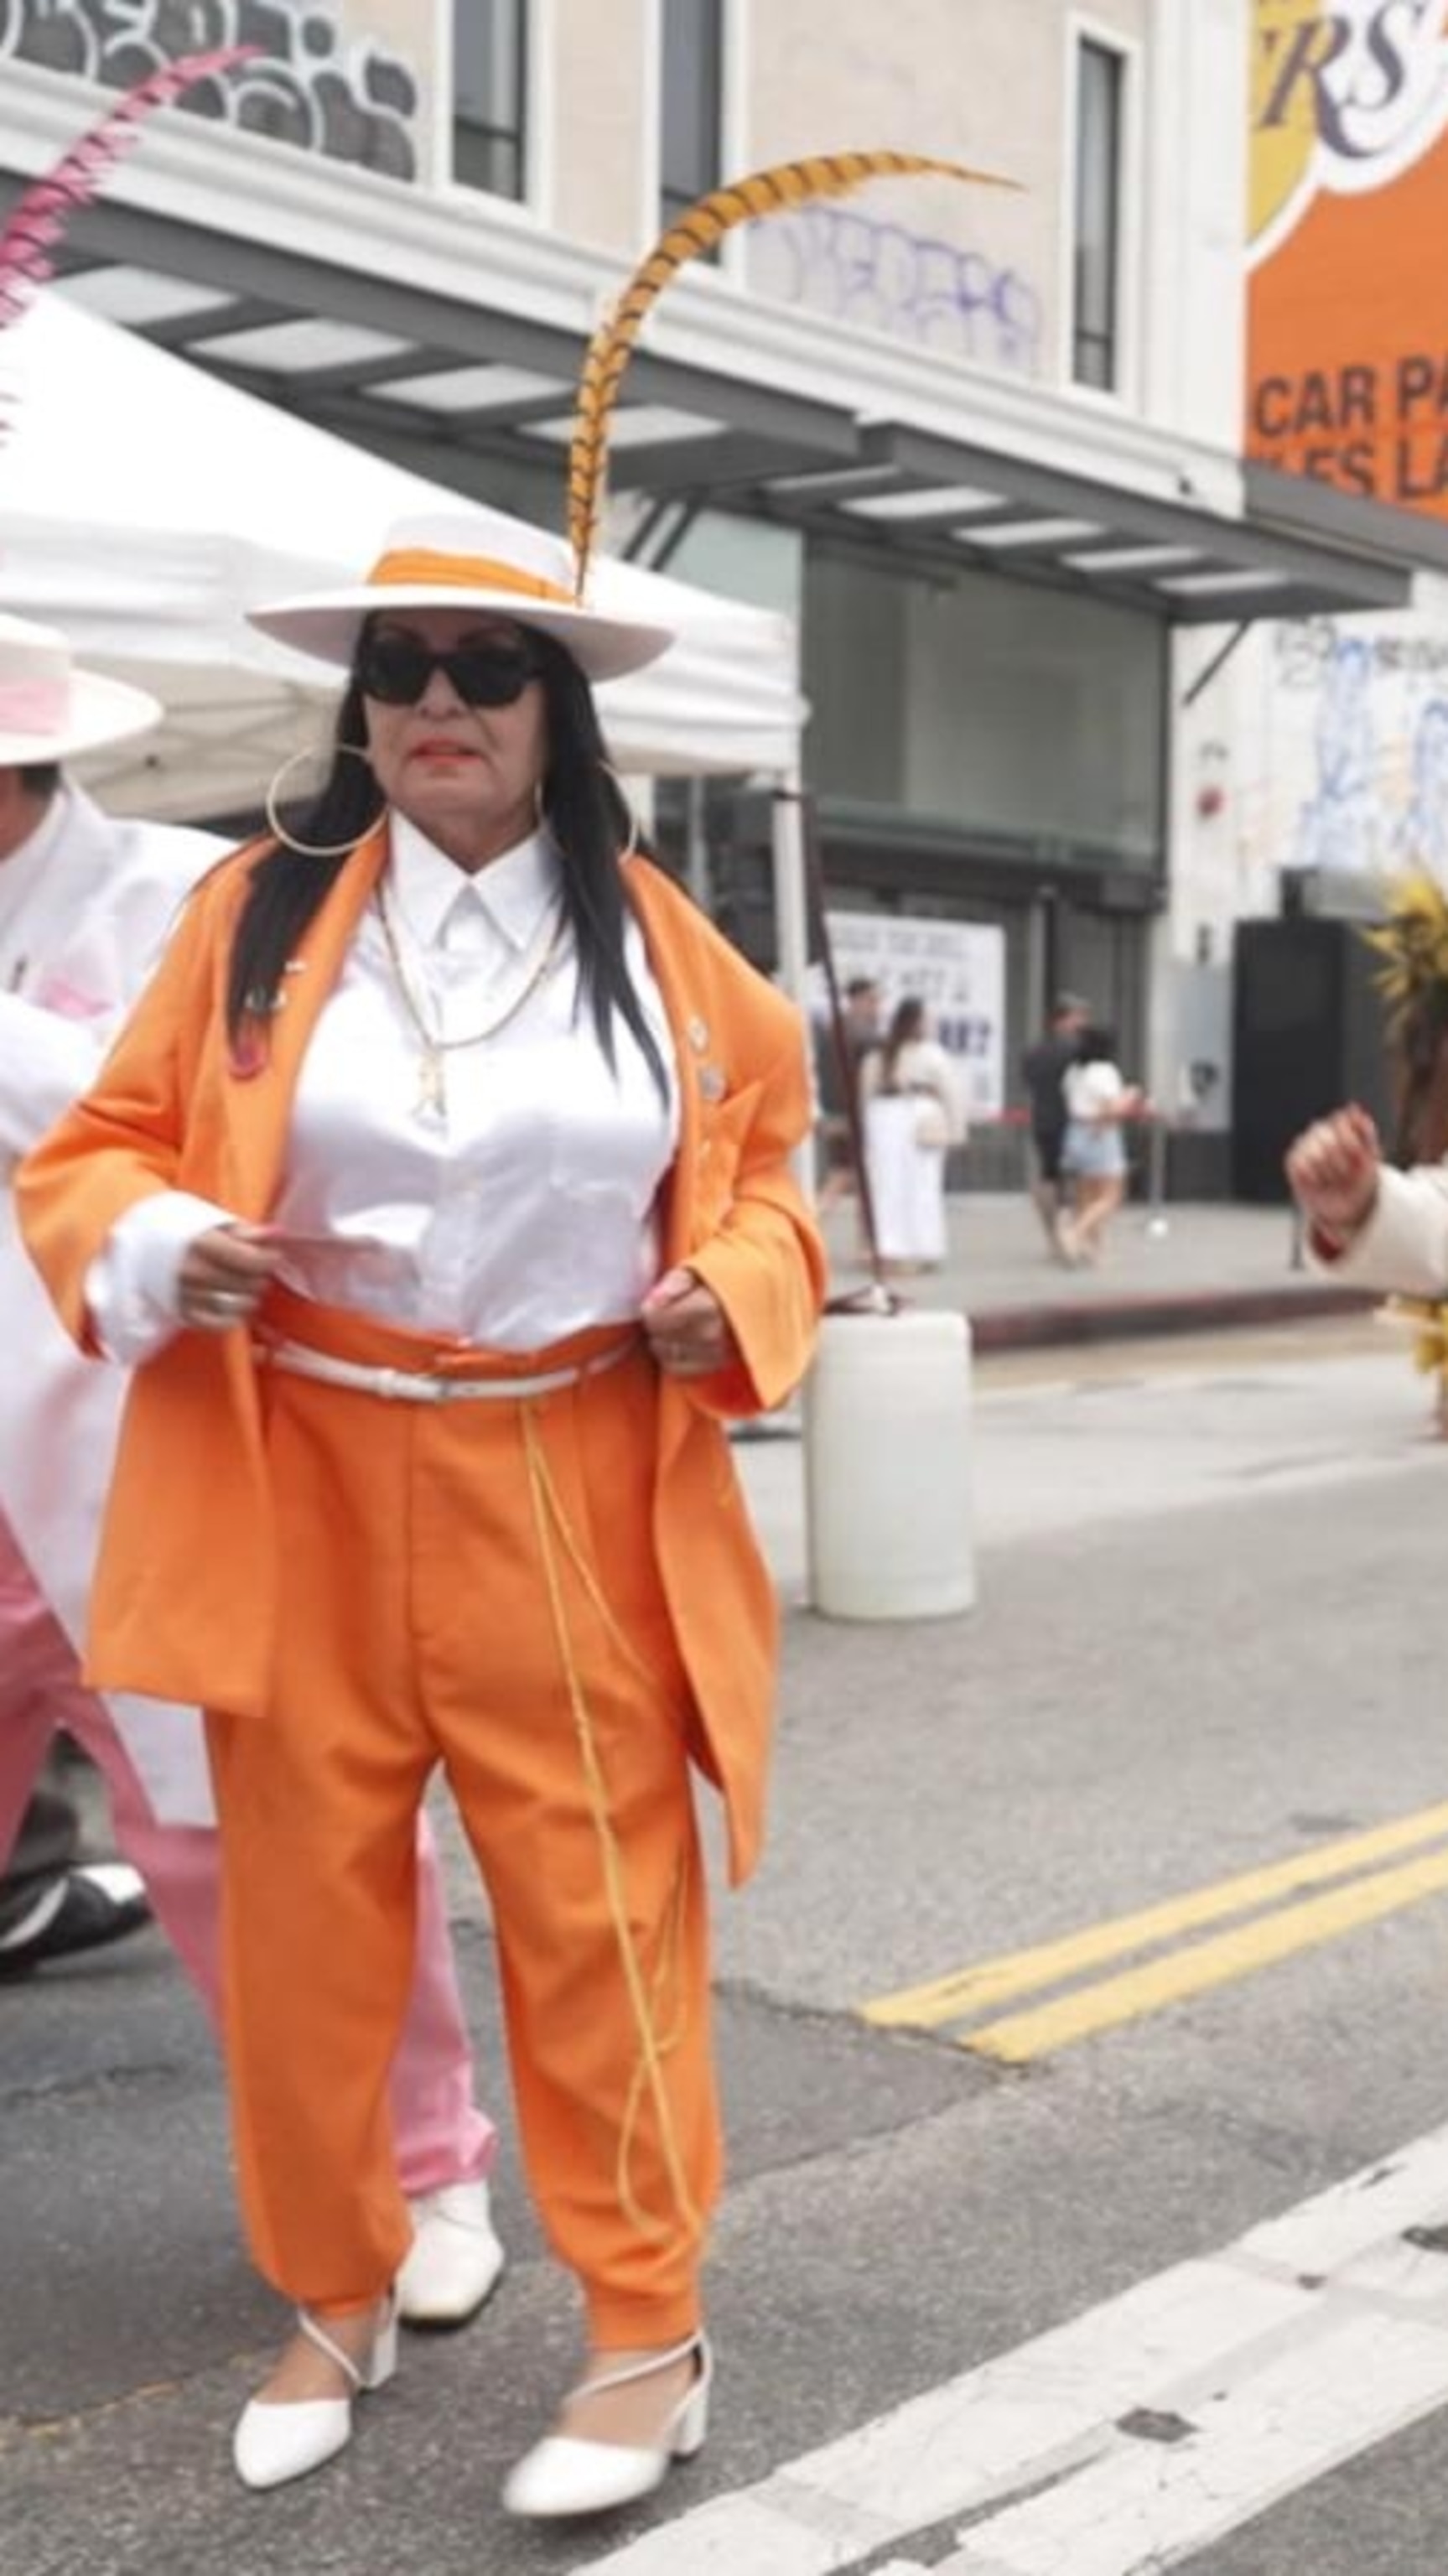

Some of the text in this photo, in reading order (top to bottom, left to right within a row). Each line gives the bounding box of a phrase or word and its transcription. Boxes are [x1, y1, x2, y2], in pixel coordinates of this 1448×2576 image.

[1253, 355, 1448, 437] CAR P
[1397, 432, 1448, 500] L
